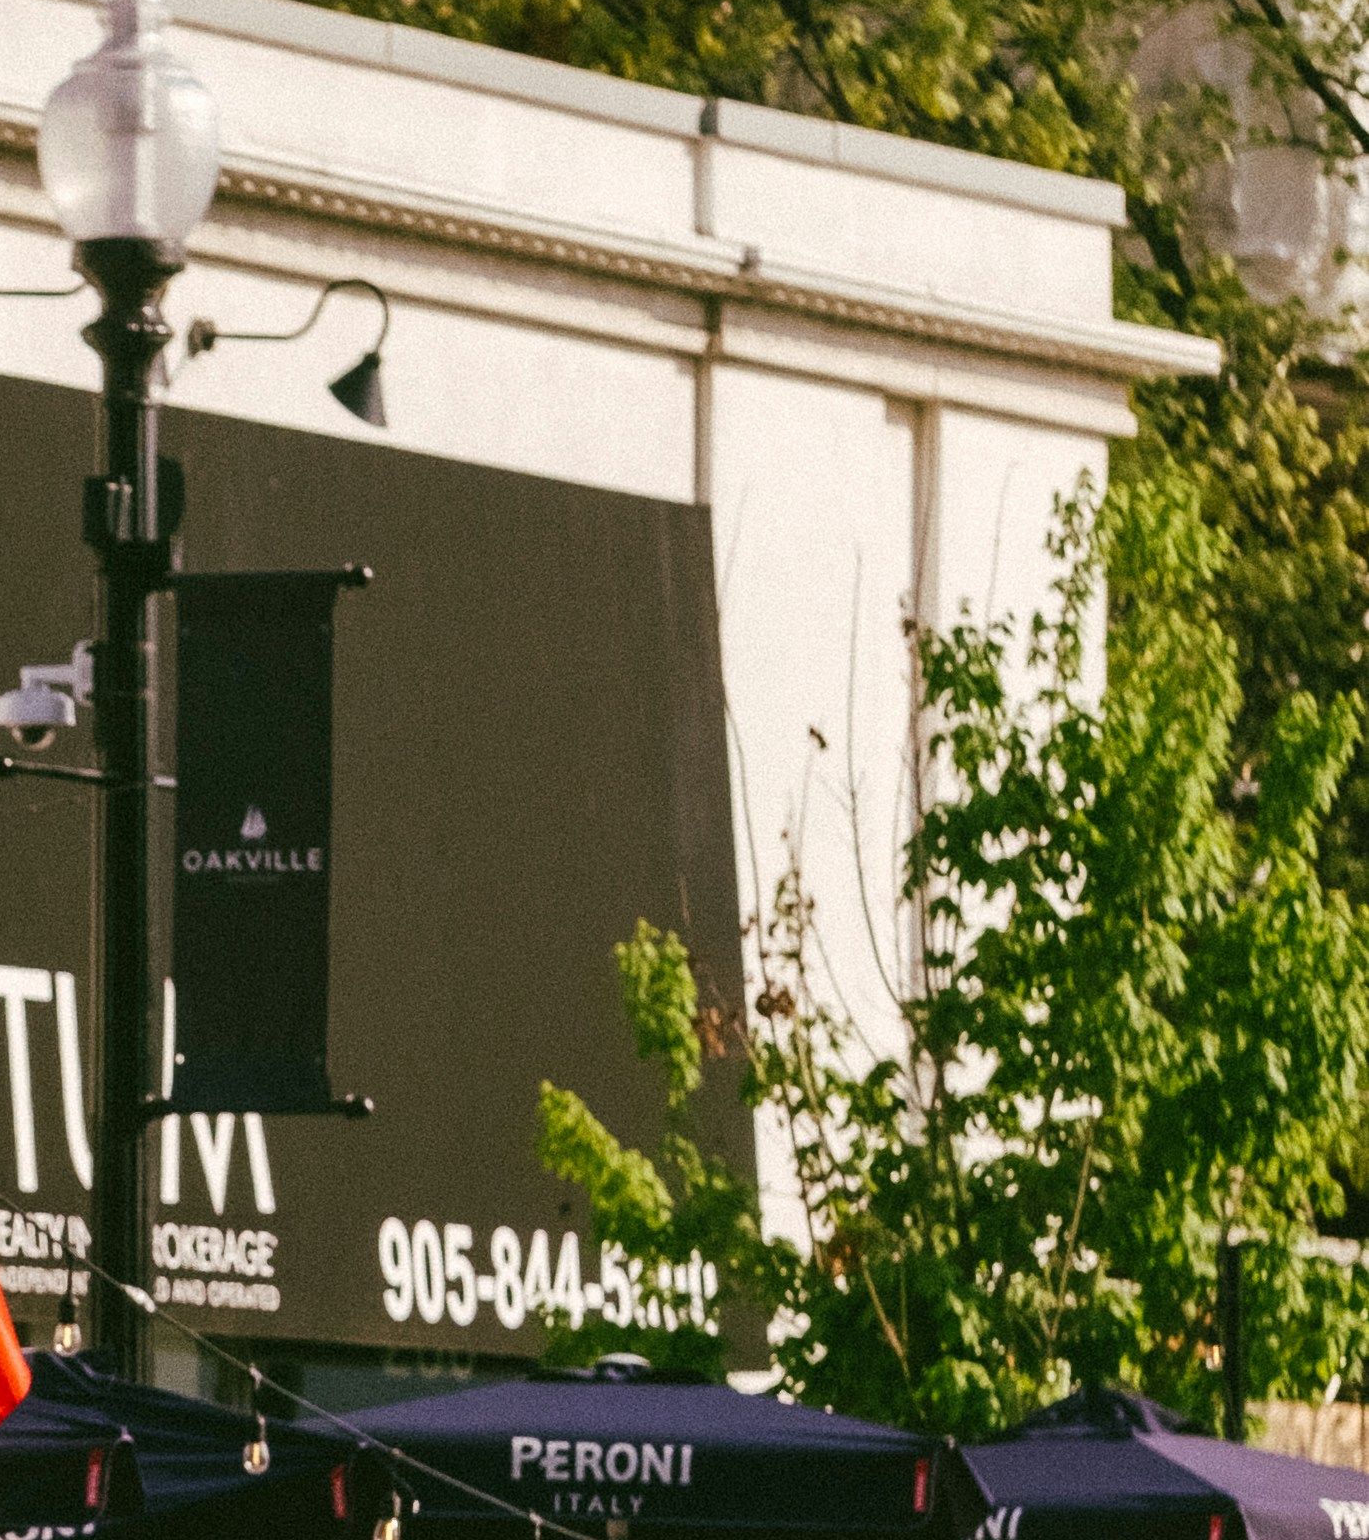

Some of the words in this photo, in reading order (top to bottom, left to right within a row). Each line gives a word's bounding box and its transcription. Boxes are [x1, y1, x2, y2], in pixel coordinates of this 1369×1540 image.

[183, 847, 323, 874] OAKVILLE
[511, 1436, 693, 1485] PERONI
[553, 1493, 643, 1516] ITALY
